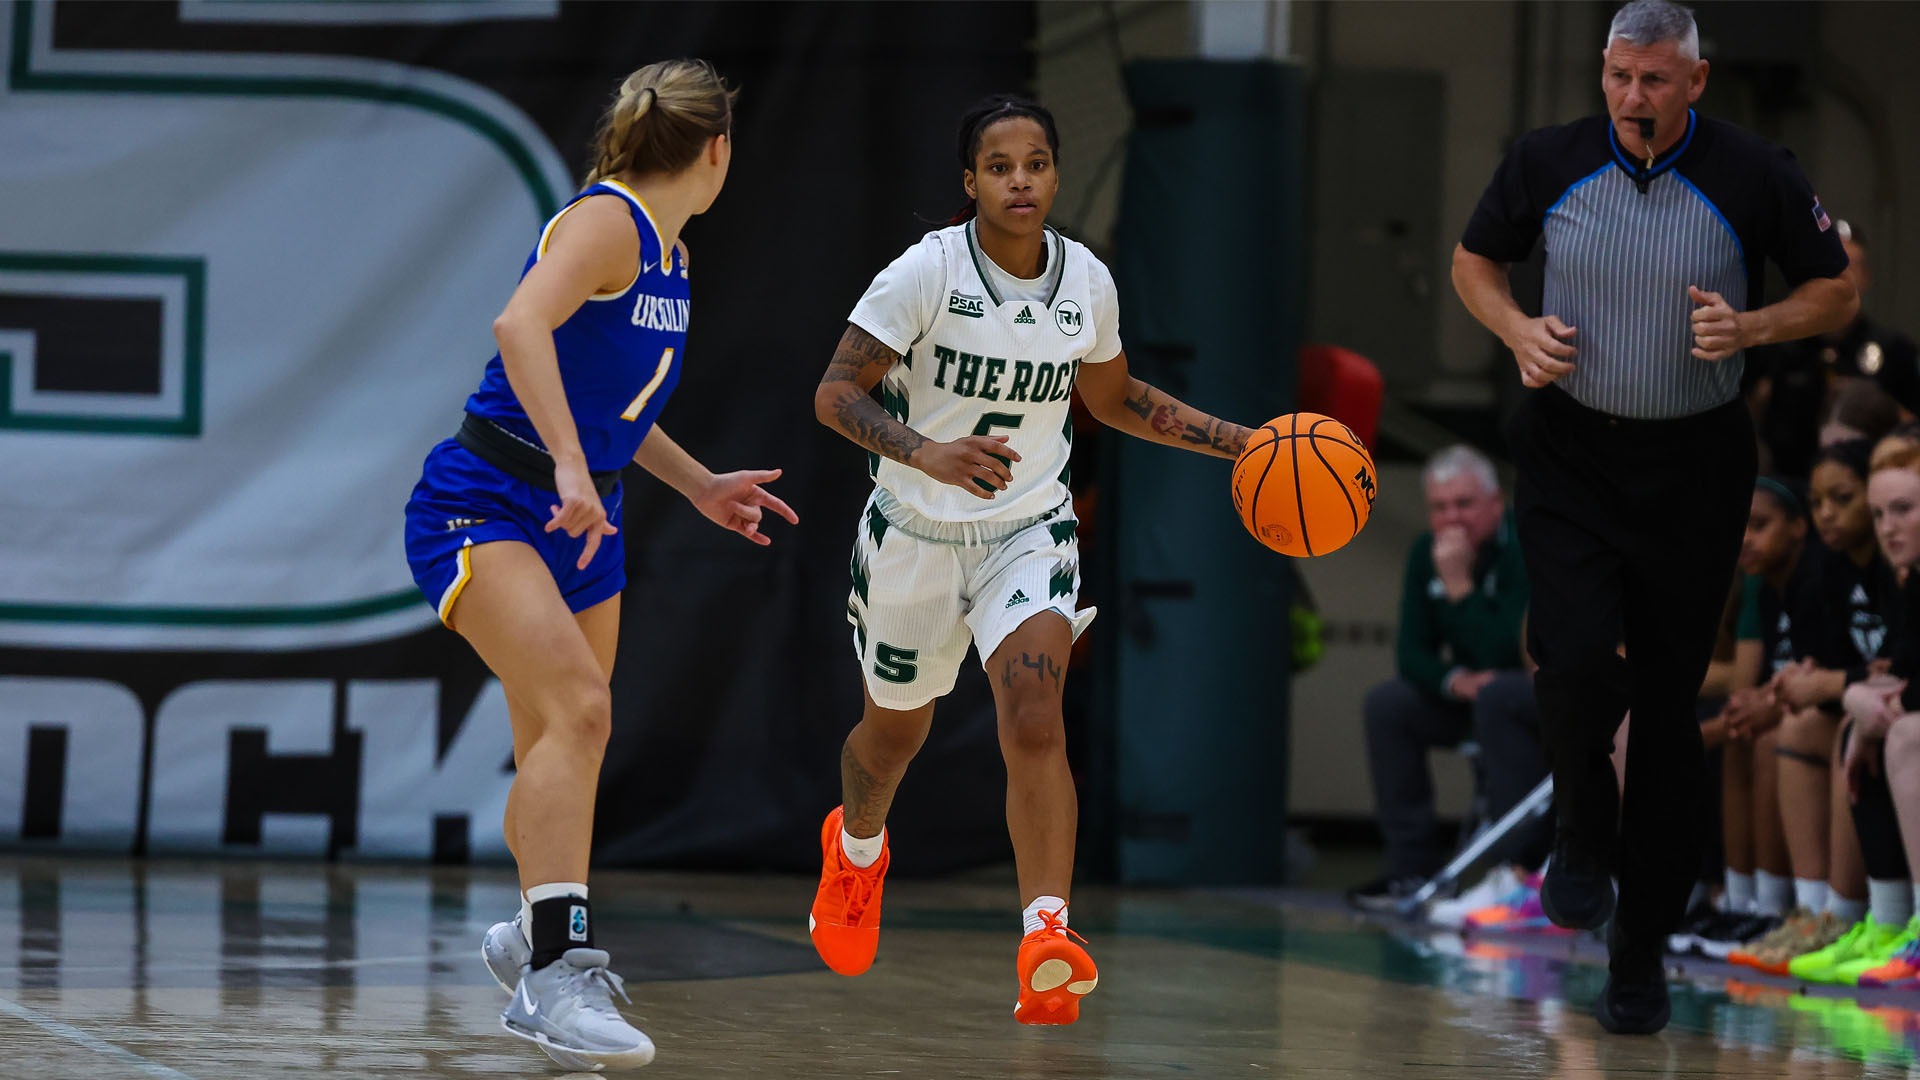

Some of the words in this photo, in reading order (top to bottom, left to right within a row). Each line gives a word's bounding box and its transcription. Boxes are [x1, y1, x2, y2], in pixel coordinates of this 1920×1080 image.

[949, 296, 984, 313] PSAC
[1013, 315, 1036, 325] adidas
[620, 347, 674, 422] 1
[934, 344, 1007, 402] THE
[1005, 597, 1030, 609] adidas
[873, 641, 918, 685] S
